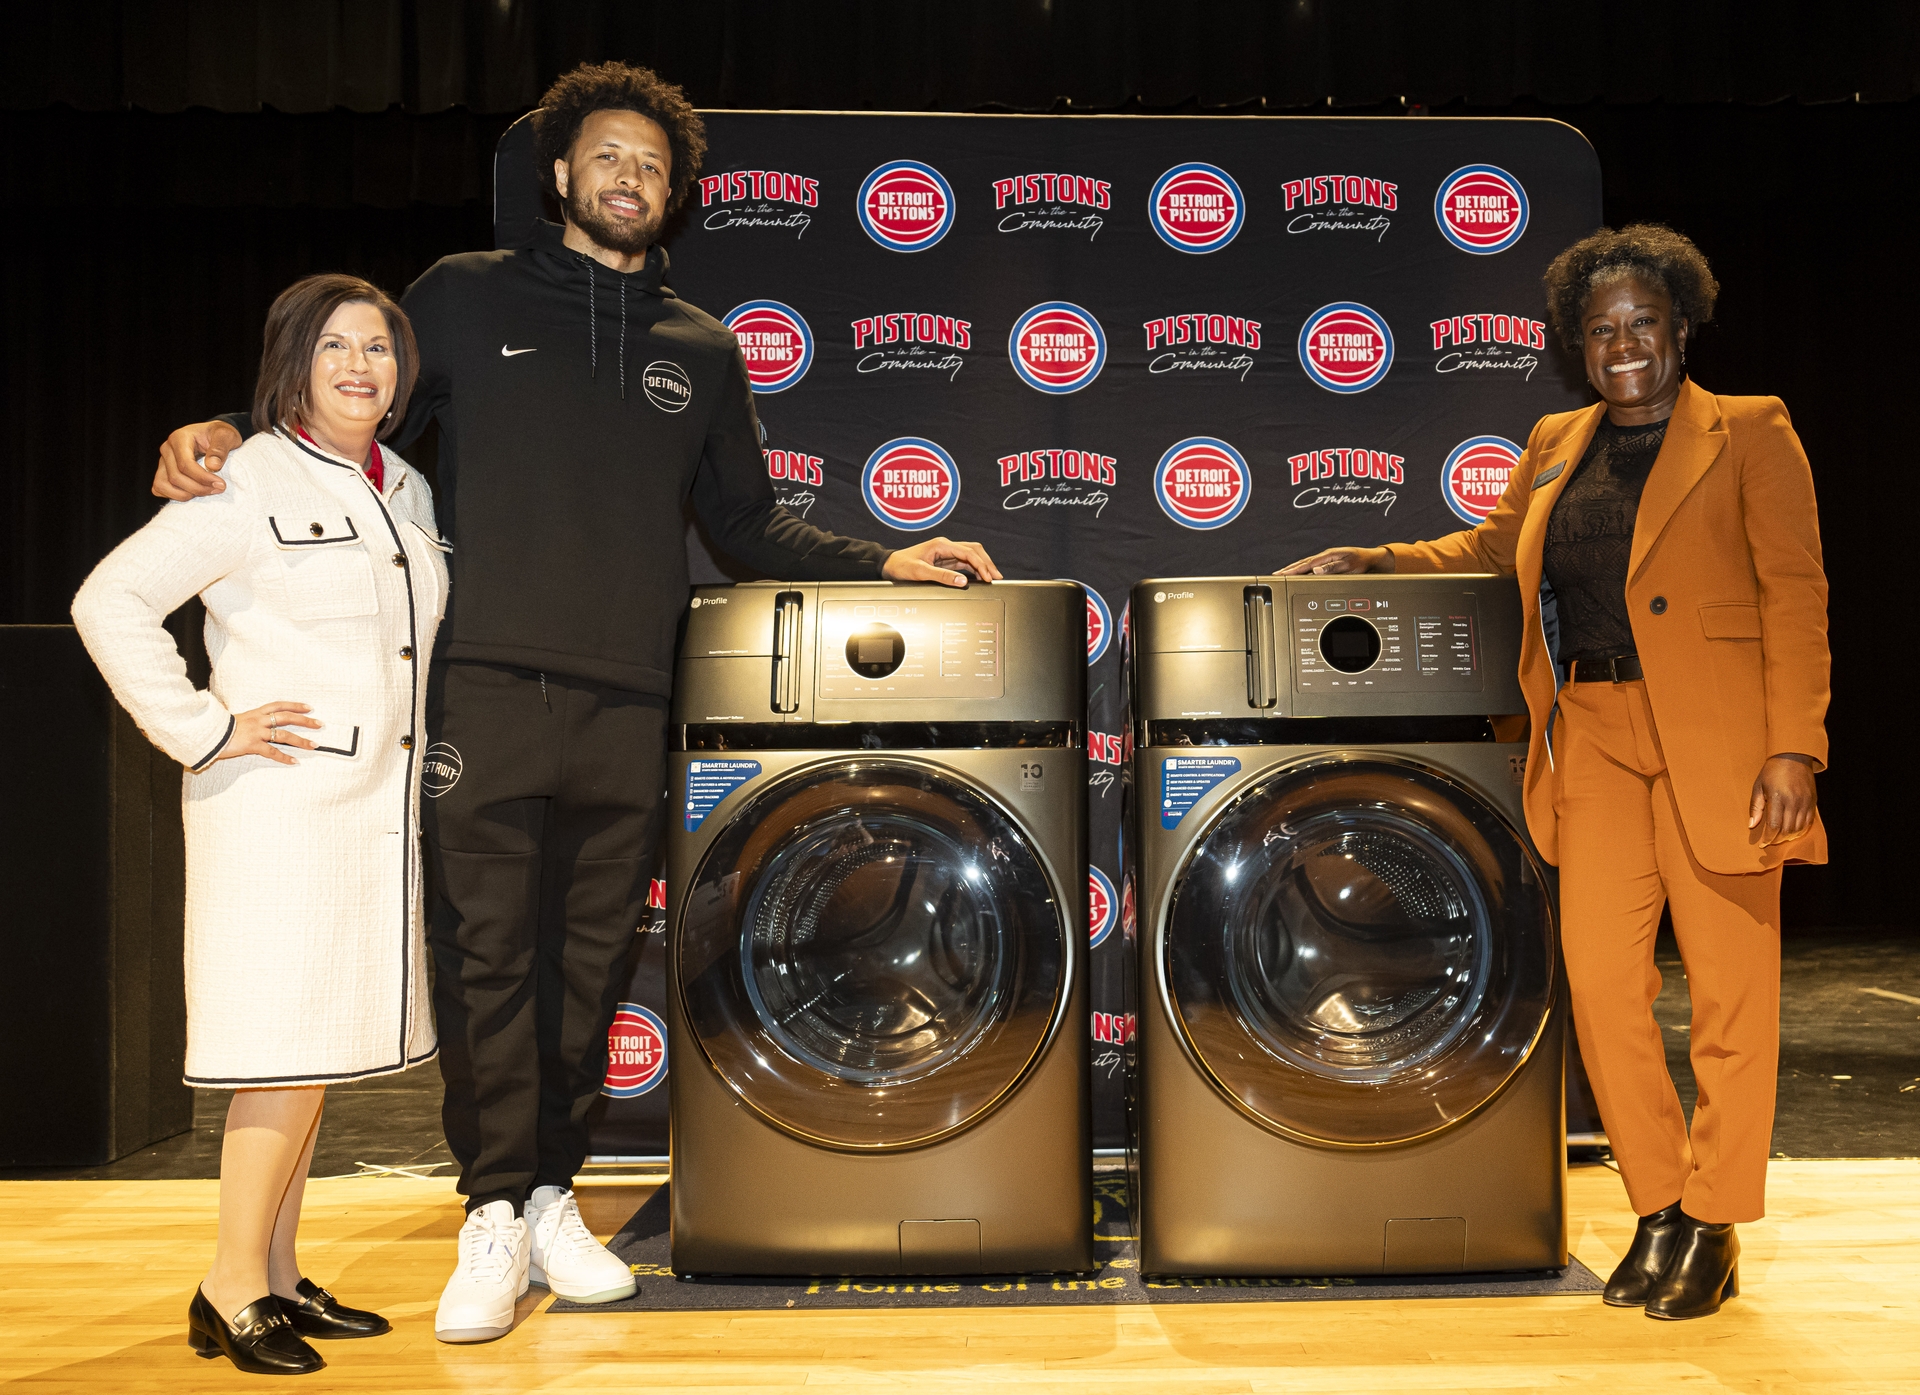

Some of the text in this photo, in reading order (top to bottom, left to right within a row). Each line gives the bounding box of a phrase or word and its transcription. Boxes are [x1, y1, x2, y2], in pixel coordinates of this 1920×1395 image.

[699, 170, 819, 208] PISTONS
[992, 173, 1112, 210] PISTONS
[1281, 174, 1398, 211] PISTONS
[878, 192, 934, 206] DETROIT
[1169, 194, 1224, 208] DETROIT
[1454, 195, 1509, 209] DETROIT
[745, 203, 774, 213] in the
[878, 206, 935, 220] PISTONS
[1038, 205, 1067, 216] in the
[1169, 208, 1225, 222] PISTONS
[1326, 207, 1354, 217] in the
[1454, 209, 1510, 223] PISTONS
[704, 209, 811, 240] Community
[998, 211, 1104, 242] Community
[1287, 213, 1391, 242] Community
[851, 313, 971, 350] PISTONS
[1143, 313, 1261, 351] PISTONS
[1430, 313, 1545, 350] PISTONS
[736, 332, 792, 346] DETROIT
[1030, 333, 1086, 347] DETROIT
[1318, 333, 1374, 347] DETROIT
[897, 345, 927, 356] in the
[1030, 348, 1086, 362] PISTONS
[1188, 346, 1218, 356] in the
[1318, 348, 1374, 362] PISTONS
[1474, 345, 1503, 356] in the
[857, 351, 963, 382] Community
[1149, 352, 1254, 382] Community
[1436, 352, 1538, 382] Community
[648, 376, 688, 398] DETROIT
[997, 448, 1117, 486] PISTONS
[1287, 447, 1405, 485] PISTONS
[883, 469, 939, 484] DETROIT
[1175, 468, 1230, 482] DETROIT
[883, 484, 940, 498] PISTONS
[1056, 482, 1072, 492] the
[1175, 483, 1231, 498] PISTONS
[1332, 480, 1362, 490] in the
[1003, 487, 1109, 518] Community
[1293, 486, 1398, 517] Community
[702, 597, 728, 606] Profile
[1168, 592, 1194, 600] Profile
[608, 1036, 652, 1050] TROIT
[609, 1051, 652, 1065] STONS
